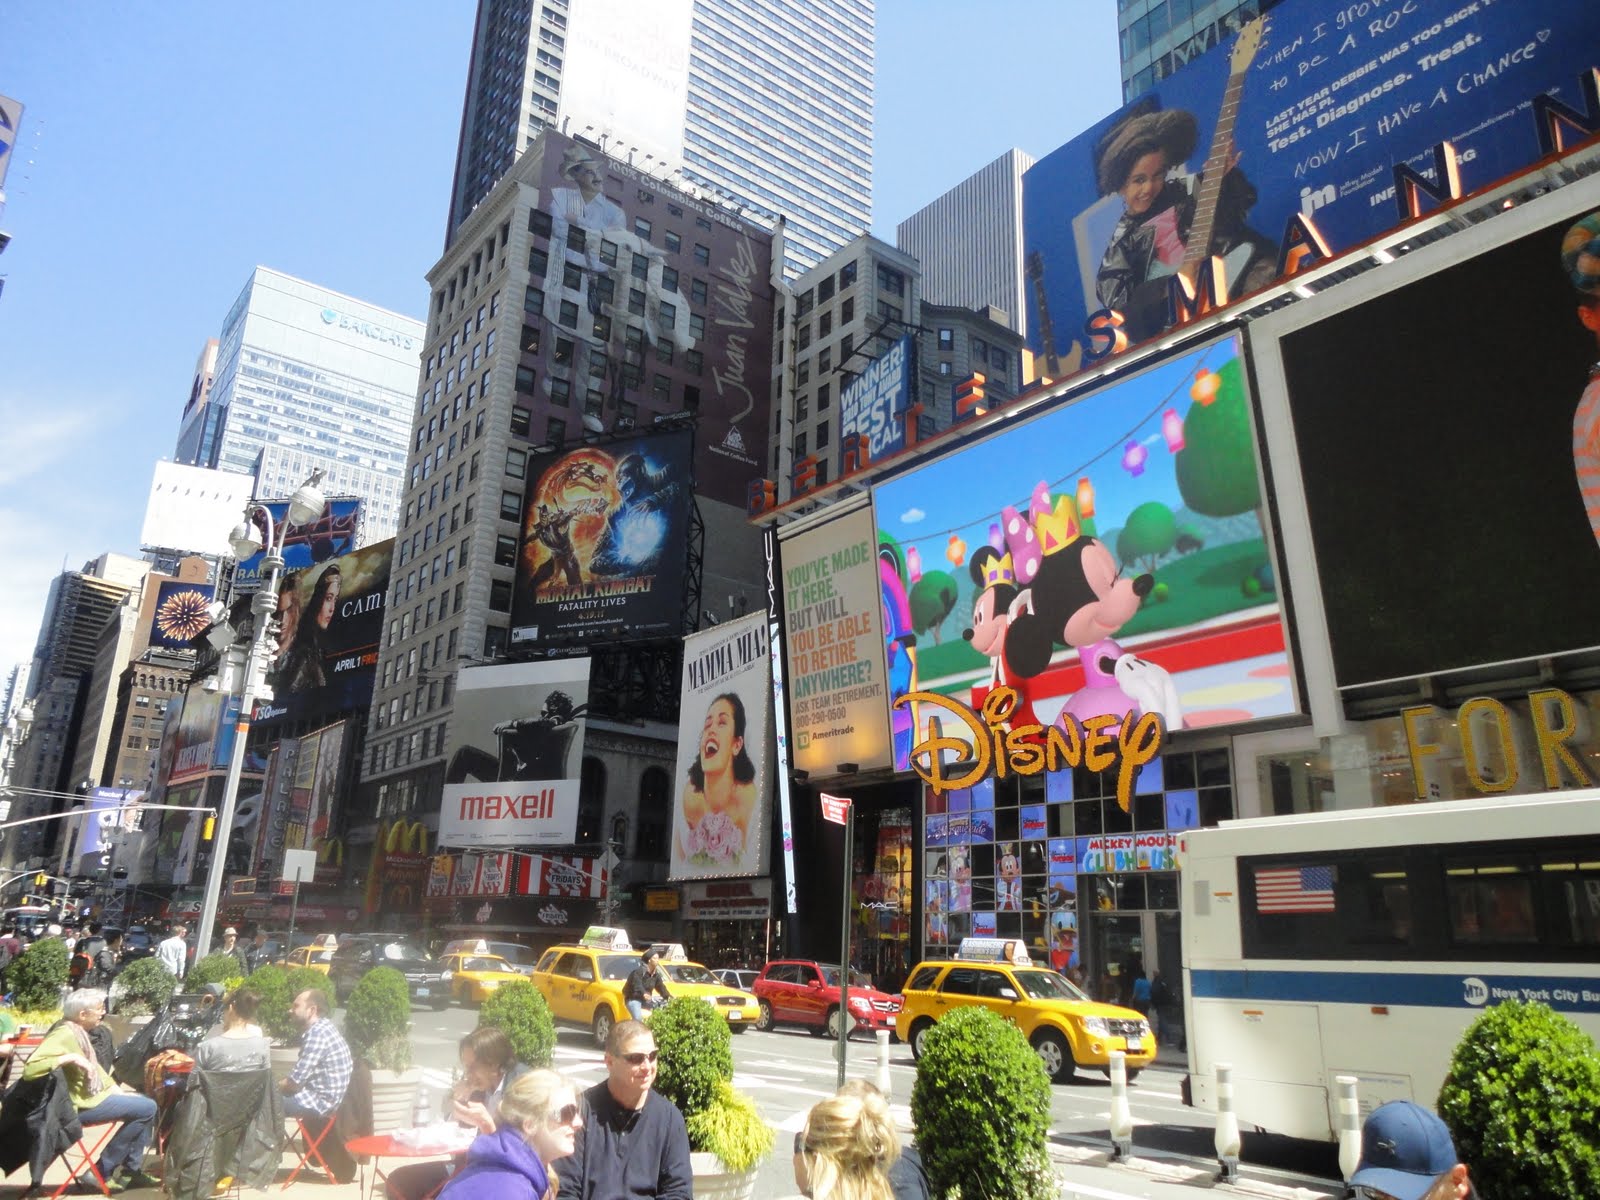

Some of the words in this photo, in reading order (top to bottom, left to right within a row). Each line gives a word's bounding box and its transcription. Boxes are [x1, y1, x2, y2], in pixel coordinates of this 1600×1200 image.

[1257, 36, 1303, 70] WHEN
[1311, 23, 1327, 43] I
[1269, 76, 1288, 91] to
[1338, 34, 1356, 55] A
[1266, 106, 1295, 129] LAST
[1297, 87, 1330, 111] YEAR
[1331, 59, 1378, 92] DEBBIE
[1379, 41, 1409, 64] WAS
[1411, 23, 1442, 46] TOO
[1444, 3, 1480, 29] SICK
[1267, 125, 1312, 154] Test.
[1316, 73, 1413, 129] Diagnose.
[1417, 32, 1483, 71] Treat.
[1267, 119, 1291, 139] SHE
[1293, 106, 1317, 124] HAS
[1294, 141, 1341, 178] NOW
[1346, 127, 1367, 153] I
[1429, 87, 1448, 109] A
[608, 159, 637, 181] 100%
[640, 174, 704, 213] Colombian
[705, 207, 743, 231] Coffee
[1340, 177, 1376, 198] Foundation
[713, 230, 758, 329] Valdez
[711, 332, 754, 424] Juan
[840, 340, 905, 410] WINNER!
[786, 556, 829, 589] YOU'VE
[832, 541, 870, 574] MADE
[535, 582, 593, 605] MORTAL
[594, 574, 657, 598] KOMBAT
[558, 601, 597, 612] FATALITY
[600, 596, 627, 608] LIVES
[788, 588, 801, 612] IT
[802, 577, 838, 607] HERE.
[789, 606, 814, 634] BUT
[815, 596, 849, 627] WILL
[790, 630, 817, 655] YOU
[818, 622, 835, 645] BE
[837, 612, 872, 640] ABLE
[334, 657, 356, 672] APRIL
[356, 655, 362, 667] 1
[688, 643, 734, 692] MAMMA
[737, 624, 766, 668] MIA!
[792, 653, 809, 677] TO
[811, 640, 858, 675] RETIRE
[794, 659, 873, 699] ANYWHERE?
[795, 699, 810, 715] ASK
[811, 695, 832, 711] TEAM
[832, 684, 883, 706] RETIREMENT.
[812, 725, 855, 741] Ameritrade
[459, 788, 555, 821] maxell
[1090, 838, 1133, 850] MICKEY
[551, 873, 582, 885] FRIDAYS
[1491, 987, 1519, 999] New
[1521, 988, 1551, 1001] York
[1553, 989, 1579, 1003] City
